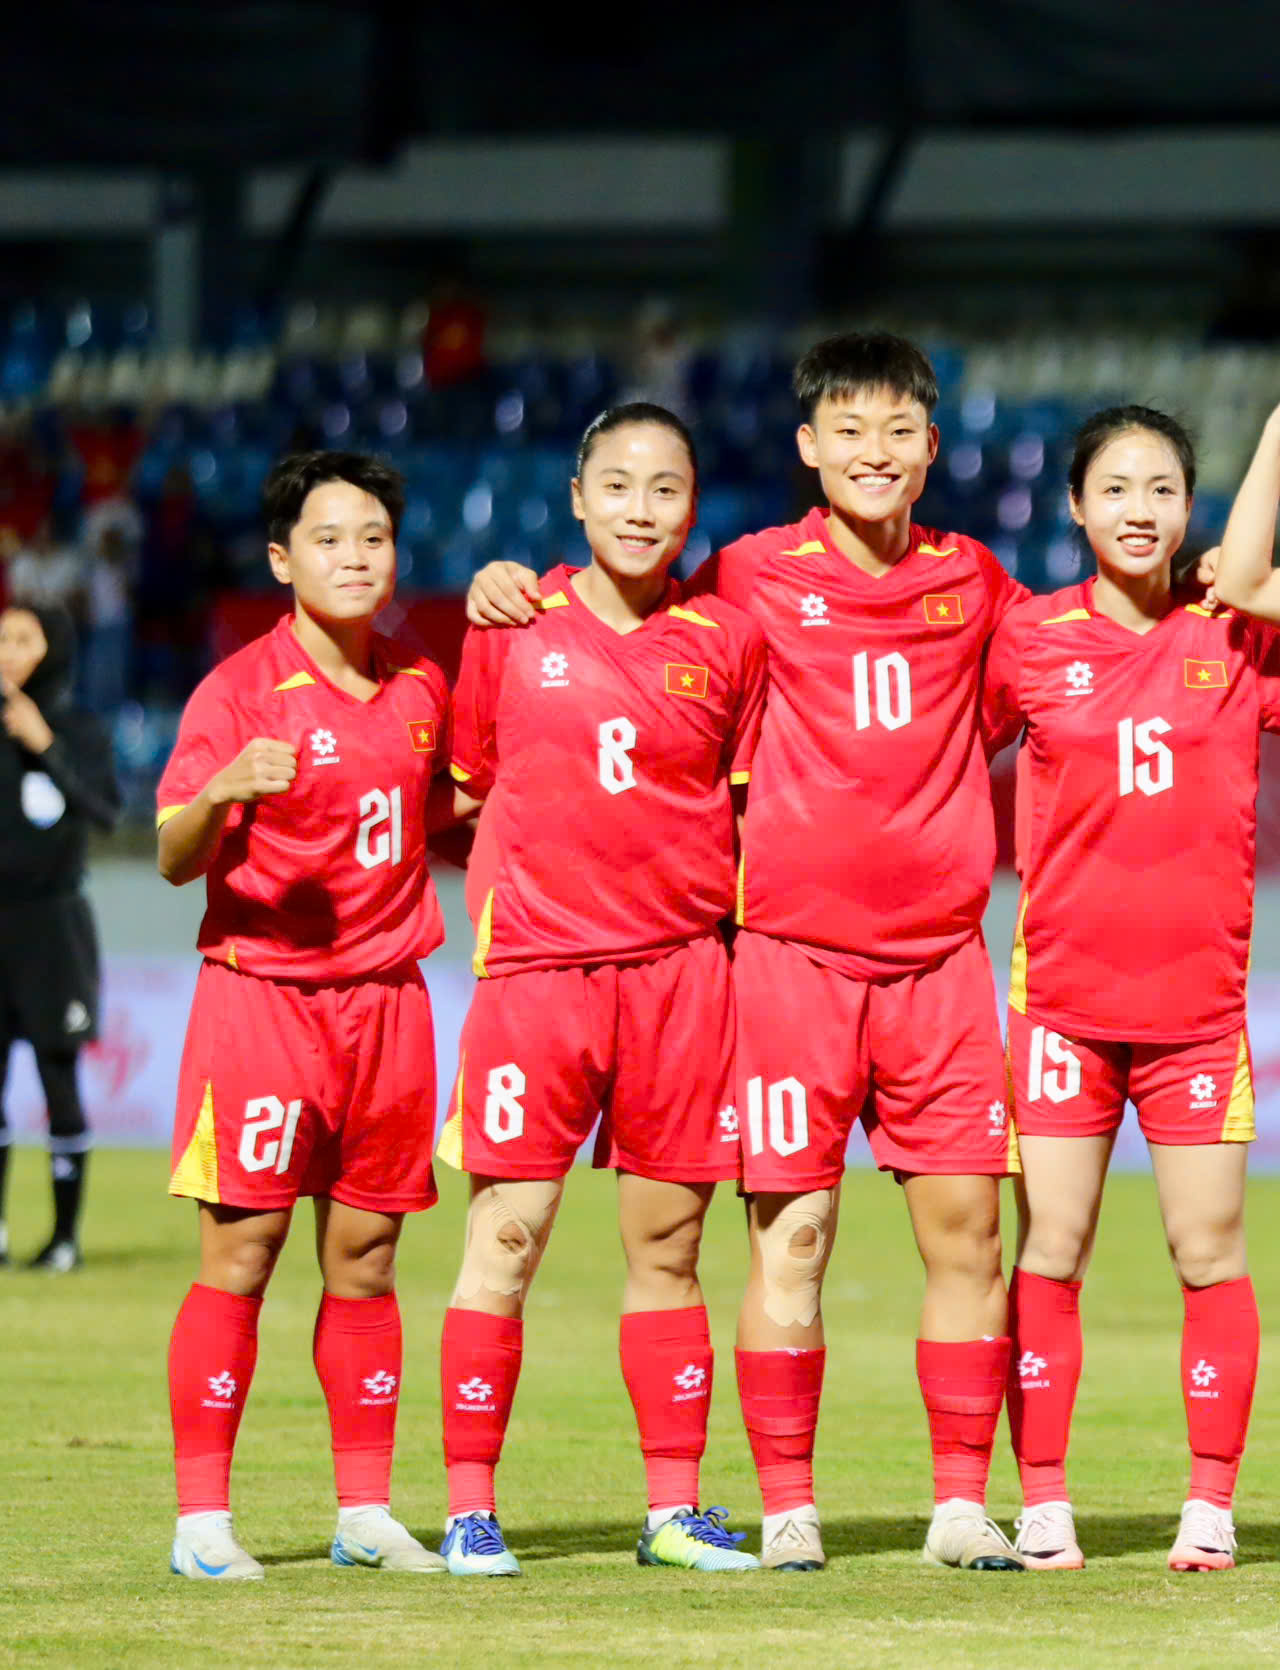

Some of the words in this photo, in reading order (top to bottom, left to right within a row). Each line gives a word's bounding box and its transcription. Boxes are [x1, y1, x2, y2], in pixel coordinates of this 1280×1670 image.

[852, 650, 912, 732] 10
[597, 716, 638, 795] 8
[1117, 715, 1174, 797] 15
[355, 786, 402, 870] 21
[483, 1063, 526, 1144] 8
[1027, 1025, 1082, 1104] 15
[238, 1095, 302, 1175] 21
[746, 1075, 809, 1157] 10
